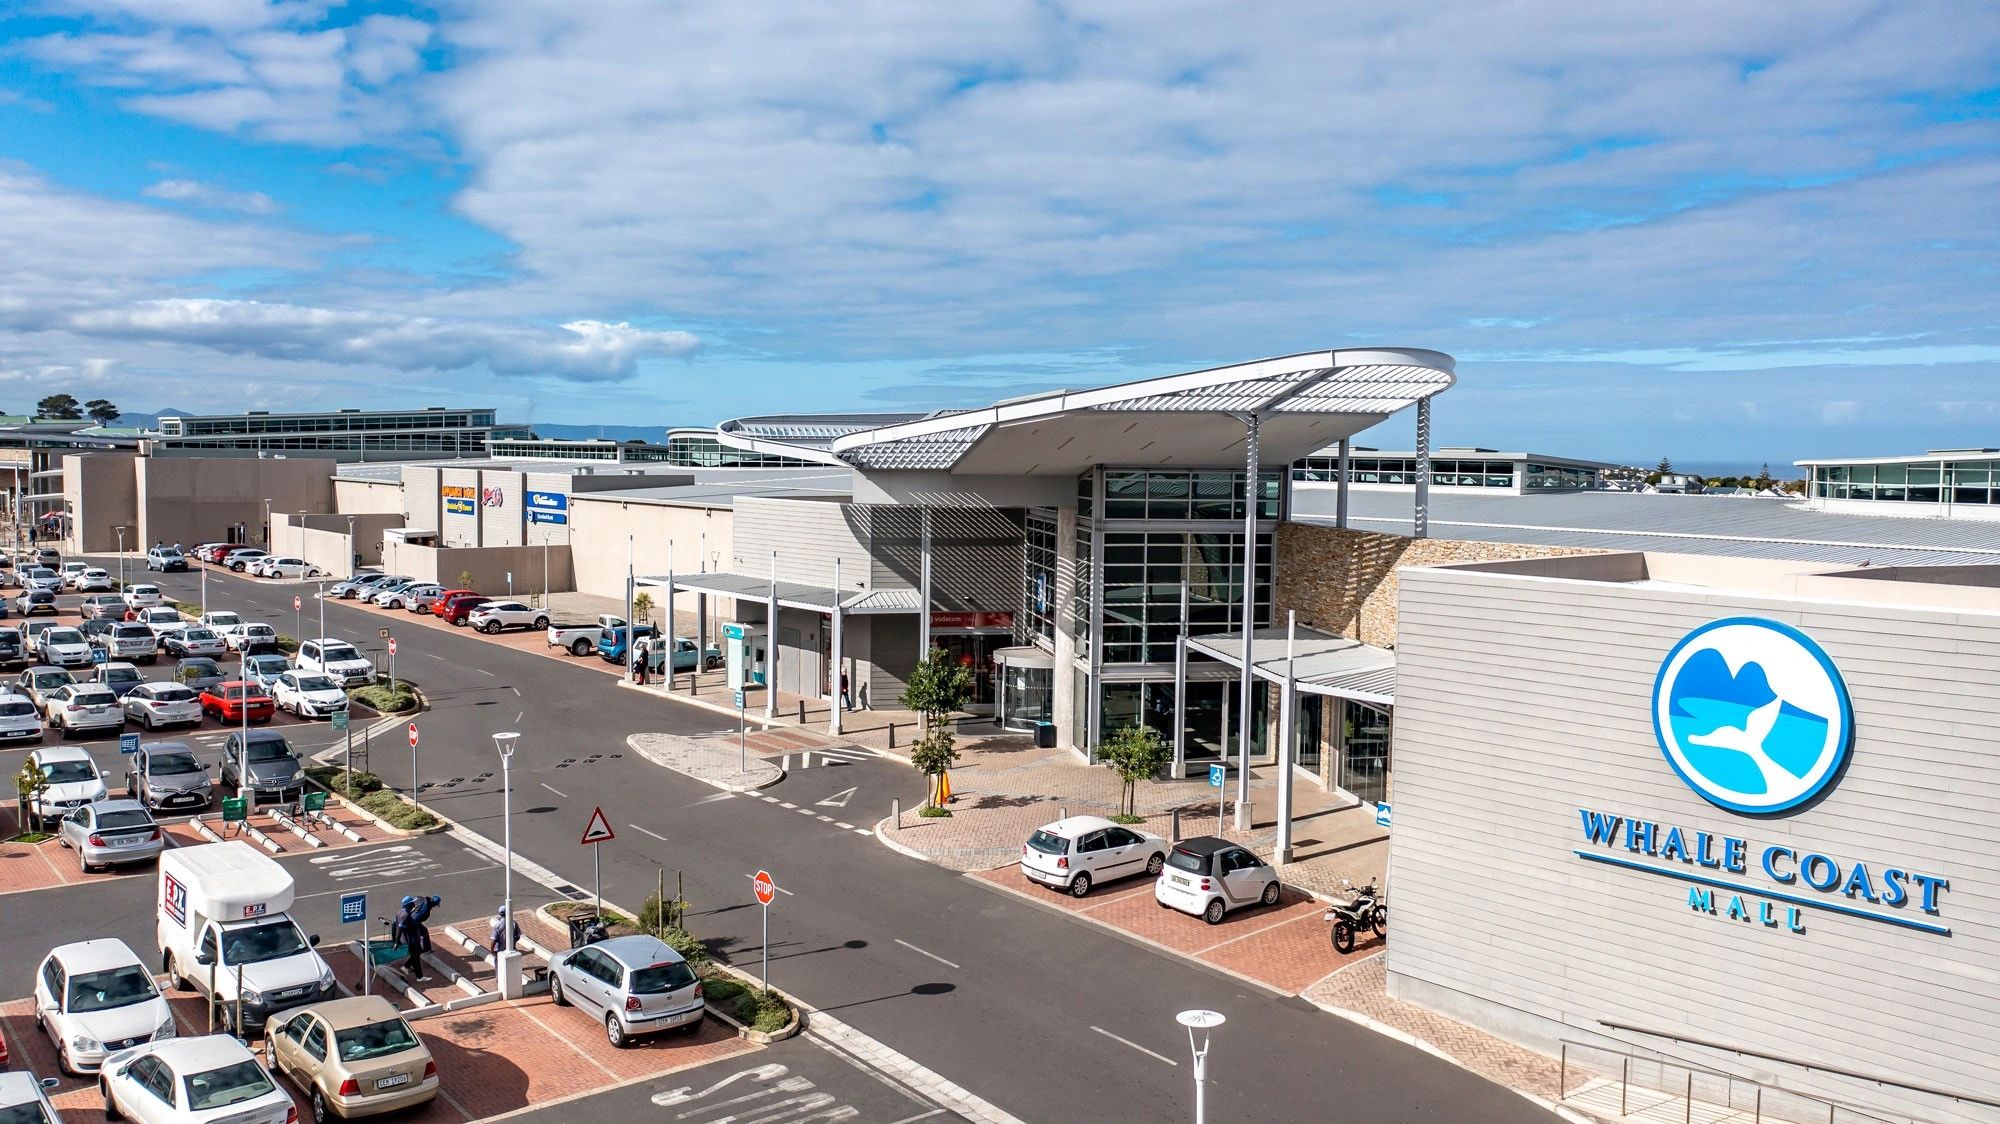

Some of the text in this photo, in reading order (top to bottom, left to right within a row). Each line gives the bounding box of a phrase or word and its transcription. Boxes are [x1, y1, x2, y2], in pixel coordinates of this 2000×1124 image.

[1578, 808, 1950, 914] WHALE COAST
[755, 879, 772, 896] STOP
[1687, 885, 1806, 933] MALL
